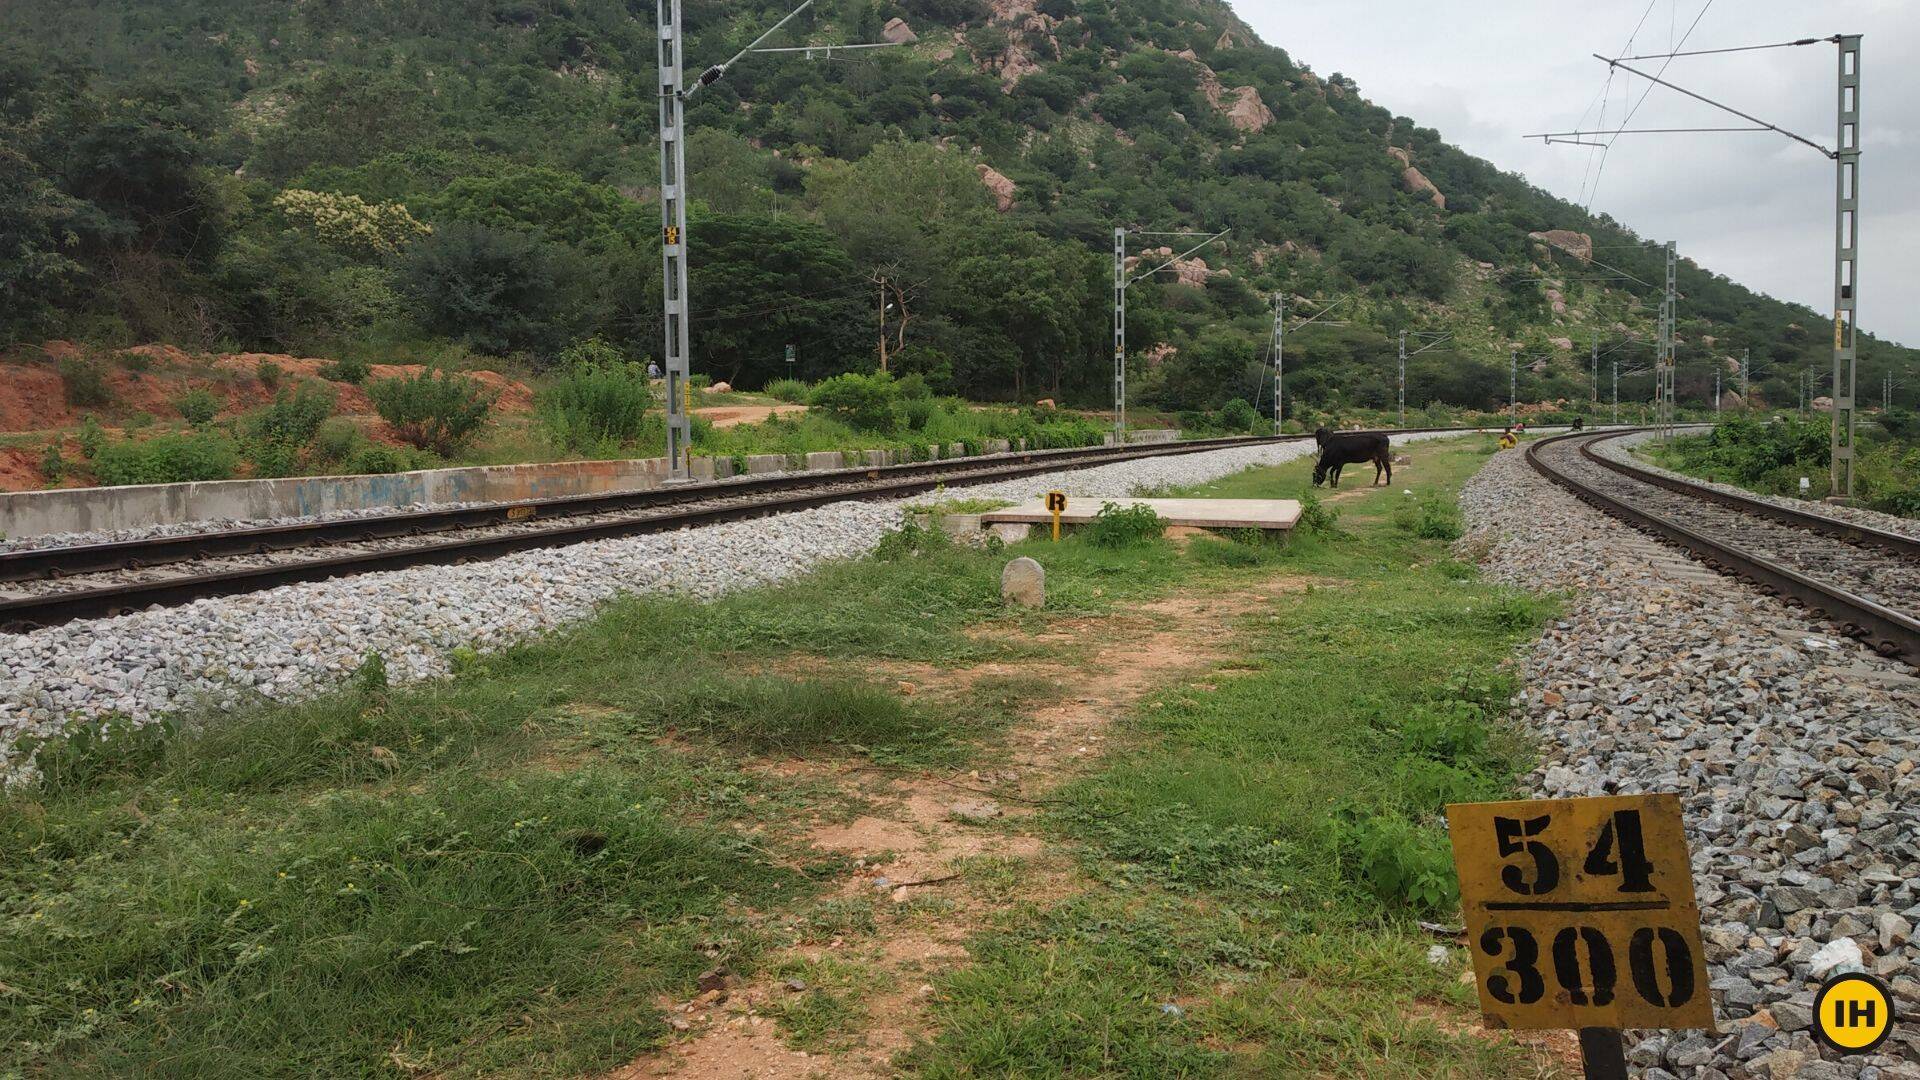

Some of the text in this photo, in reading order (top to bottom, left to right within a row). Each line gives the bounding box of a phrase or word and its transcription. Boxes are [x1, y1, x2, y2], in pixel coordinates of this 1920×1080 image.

[1049, 492, 1066, 511] R
[1494, 809, 1657, 895] 54
[1480, 926, 1695, 1008] 300
